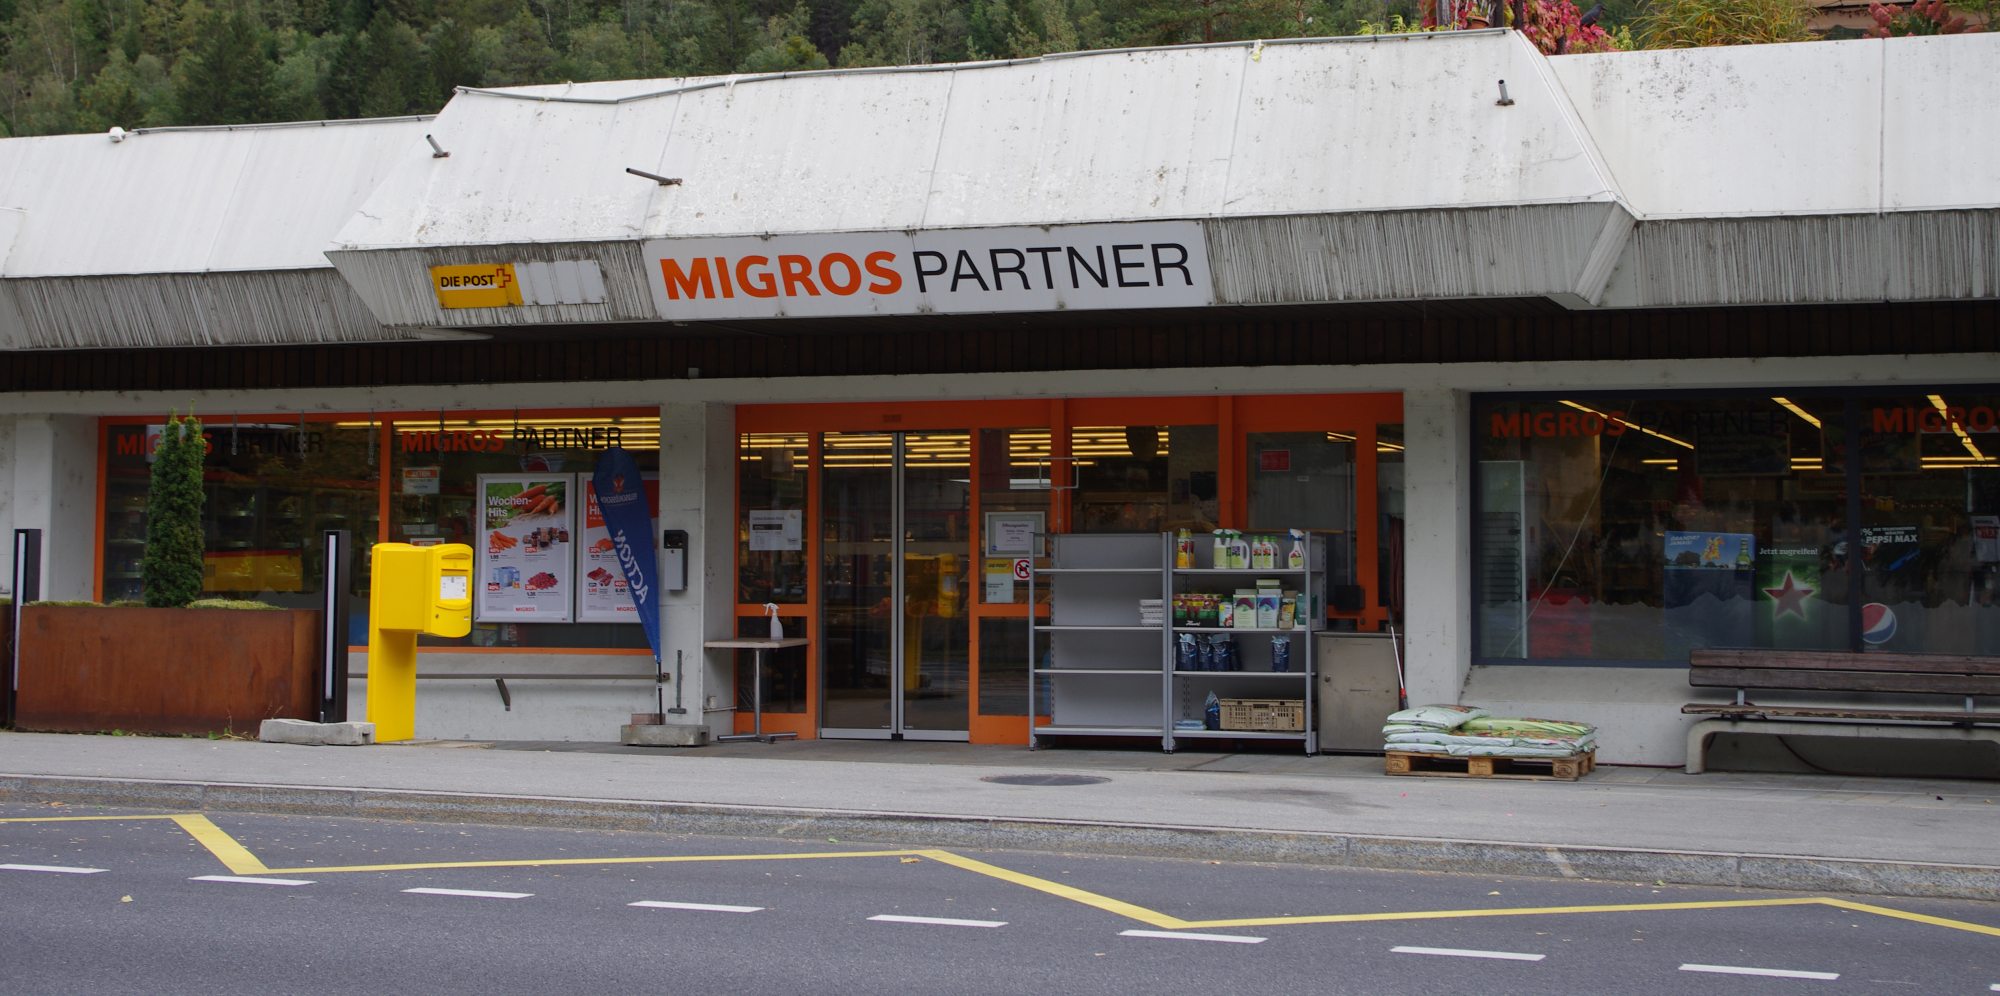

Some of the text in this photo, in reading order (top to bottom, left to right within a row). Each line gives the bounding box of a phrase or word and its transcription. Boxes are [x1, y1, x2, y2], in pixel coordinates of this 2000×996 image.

[659, 242, 1194, 300] MIGROS PARTNER
[440, 275, 495, 288] DIE POST
[1491, 409, 1790, 438] MIGROS PARTNER
[1872, 405, 2000, 434] MIGRO
[116, 431, 324, 455] MIGS PARTNER
[401, 427, 622, 453] MIGROS PARTNER
[1814, 480, 1847, 488] TIERFUTTE
[488, 495, 532, 506] Wochen-
[488, 507, 508, 517] Hits
[589, 505, 603, 515] Hi
[1865, 534, 1918, 544] PEPSI MAX
[1758, 548, 1818, 557] Jetzt zugreifen!
